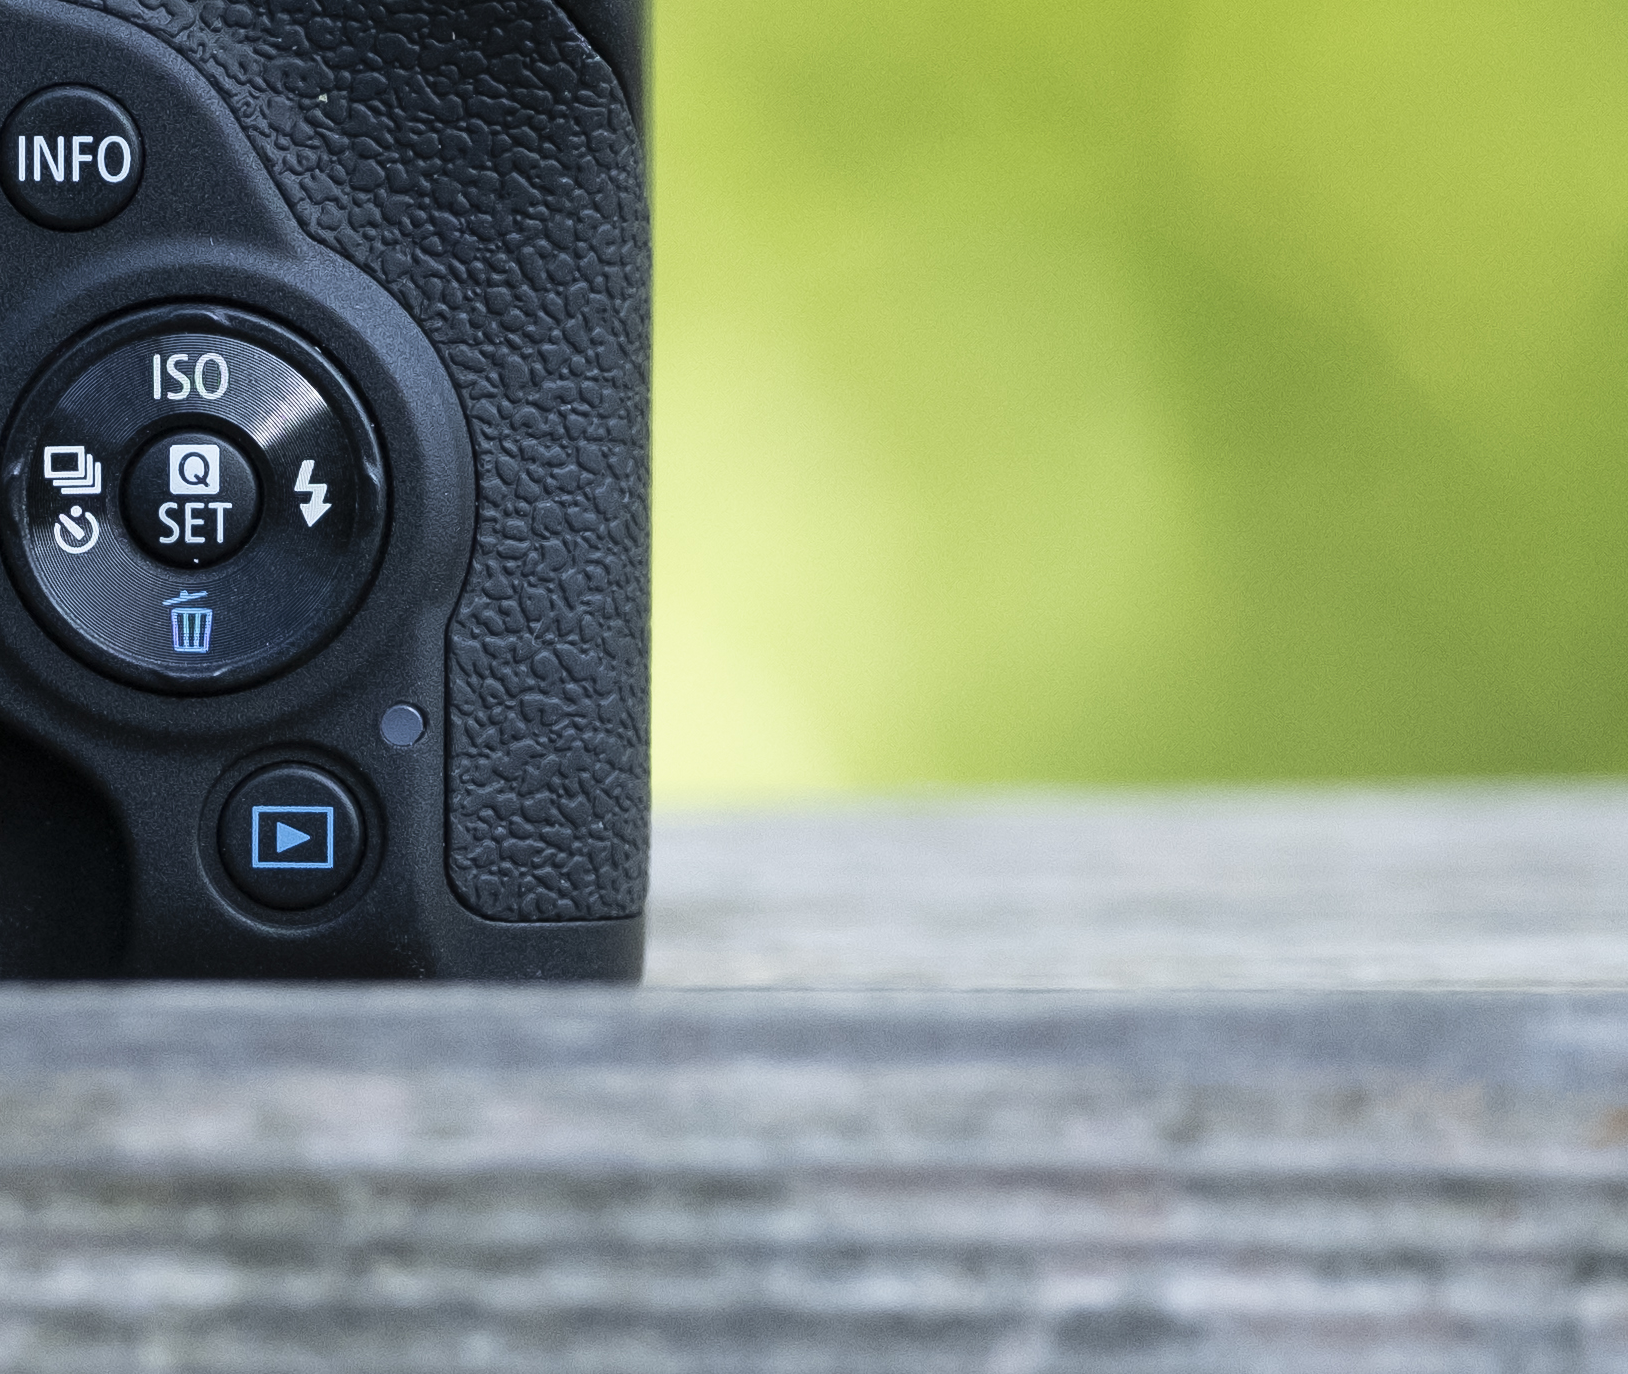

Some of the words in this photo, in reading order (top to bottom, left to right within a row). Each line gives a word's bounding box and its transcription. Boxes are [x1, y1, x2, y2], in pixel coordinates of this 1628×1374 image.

[18, 135, 132, 183] INFO
[151, 351, 230, 401] ISO
[177, 451, 211, 490] Q
[158, 501, 233, 544] SET
